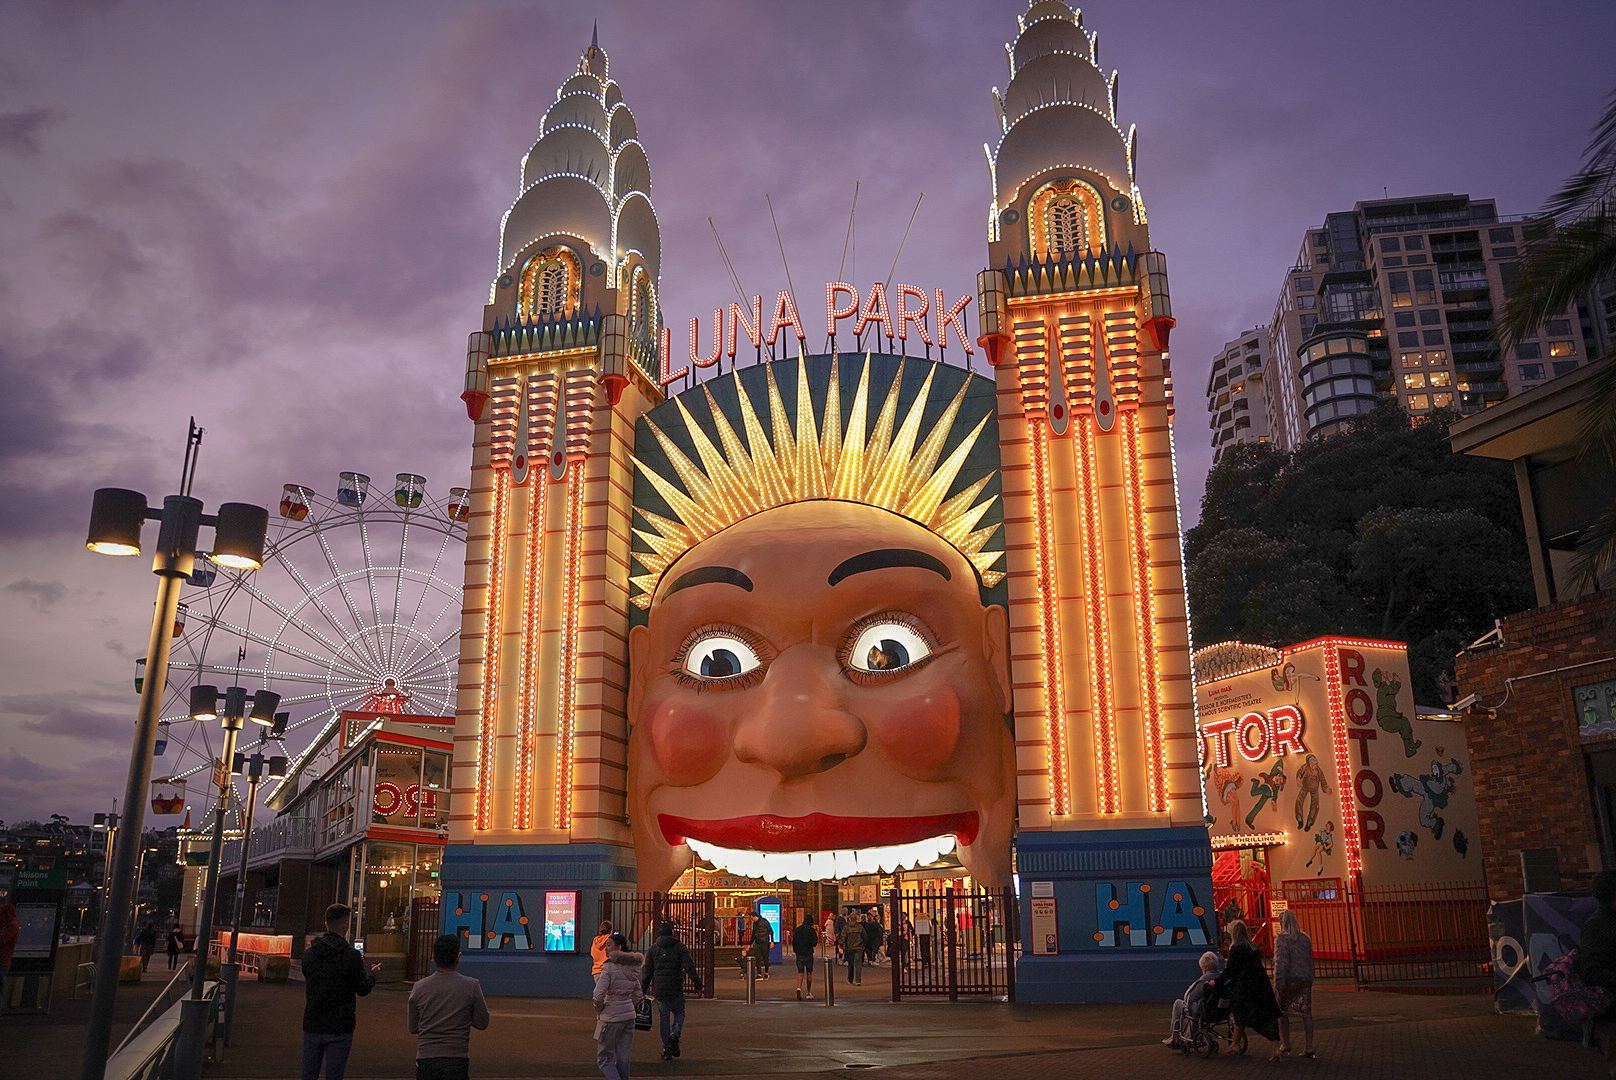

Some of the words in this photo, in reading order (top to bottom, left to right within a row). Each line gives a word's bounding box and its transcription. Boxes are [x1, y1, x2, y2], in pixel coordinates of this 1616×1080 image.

[659, 289, 806, 386] LUNA
[825, 281, 975, 355] PARK
[1197, 702, 1215, 711] FESSOR
[1242, 697, 1262, 708] THEATRE
[1197, 705, 1305, 768] TOR
[1337, 648, 1388, 850] ROTOR
[18, 871, 49, 879] Milsons
[17, 879, 39, 887] Point
